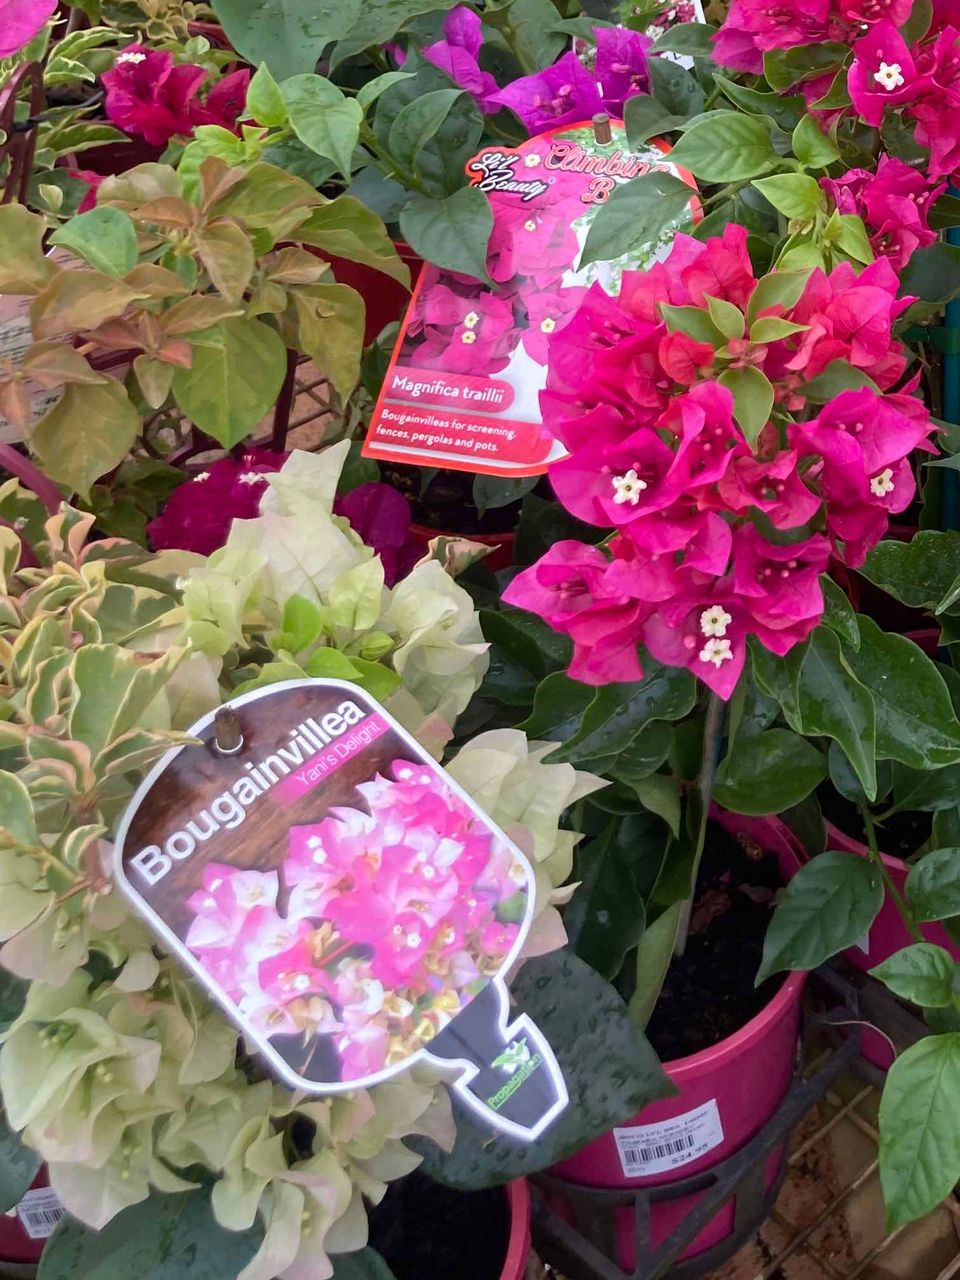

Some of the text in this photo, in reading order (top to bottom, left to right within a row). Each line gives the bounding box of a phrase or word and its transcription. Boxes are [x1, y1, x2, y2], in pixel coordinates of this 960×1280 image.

[471, 144, 671, 178] Li'l Climbin
[476, 171, 548, 201] Beauty
[392, 376, 504, 404] Magnifica traillii
[376, 424, 499, 453] fences, pergolas and pots.
[380, 408, 517, 441] Bougainvilleas for screening,
[296, 720, 382, 787] Yani's Delight
[130, 699, 367, 887] Bougainvillea
